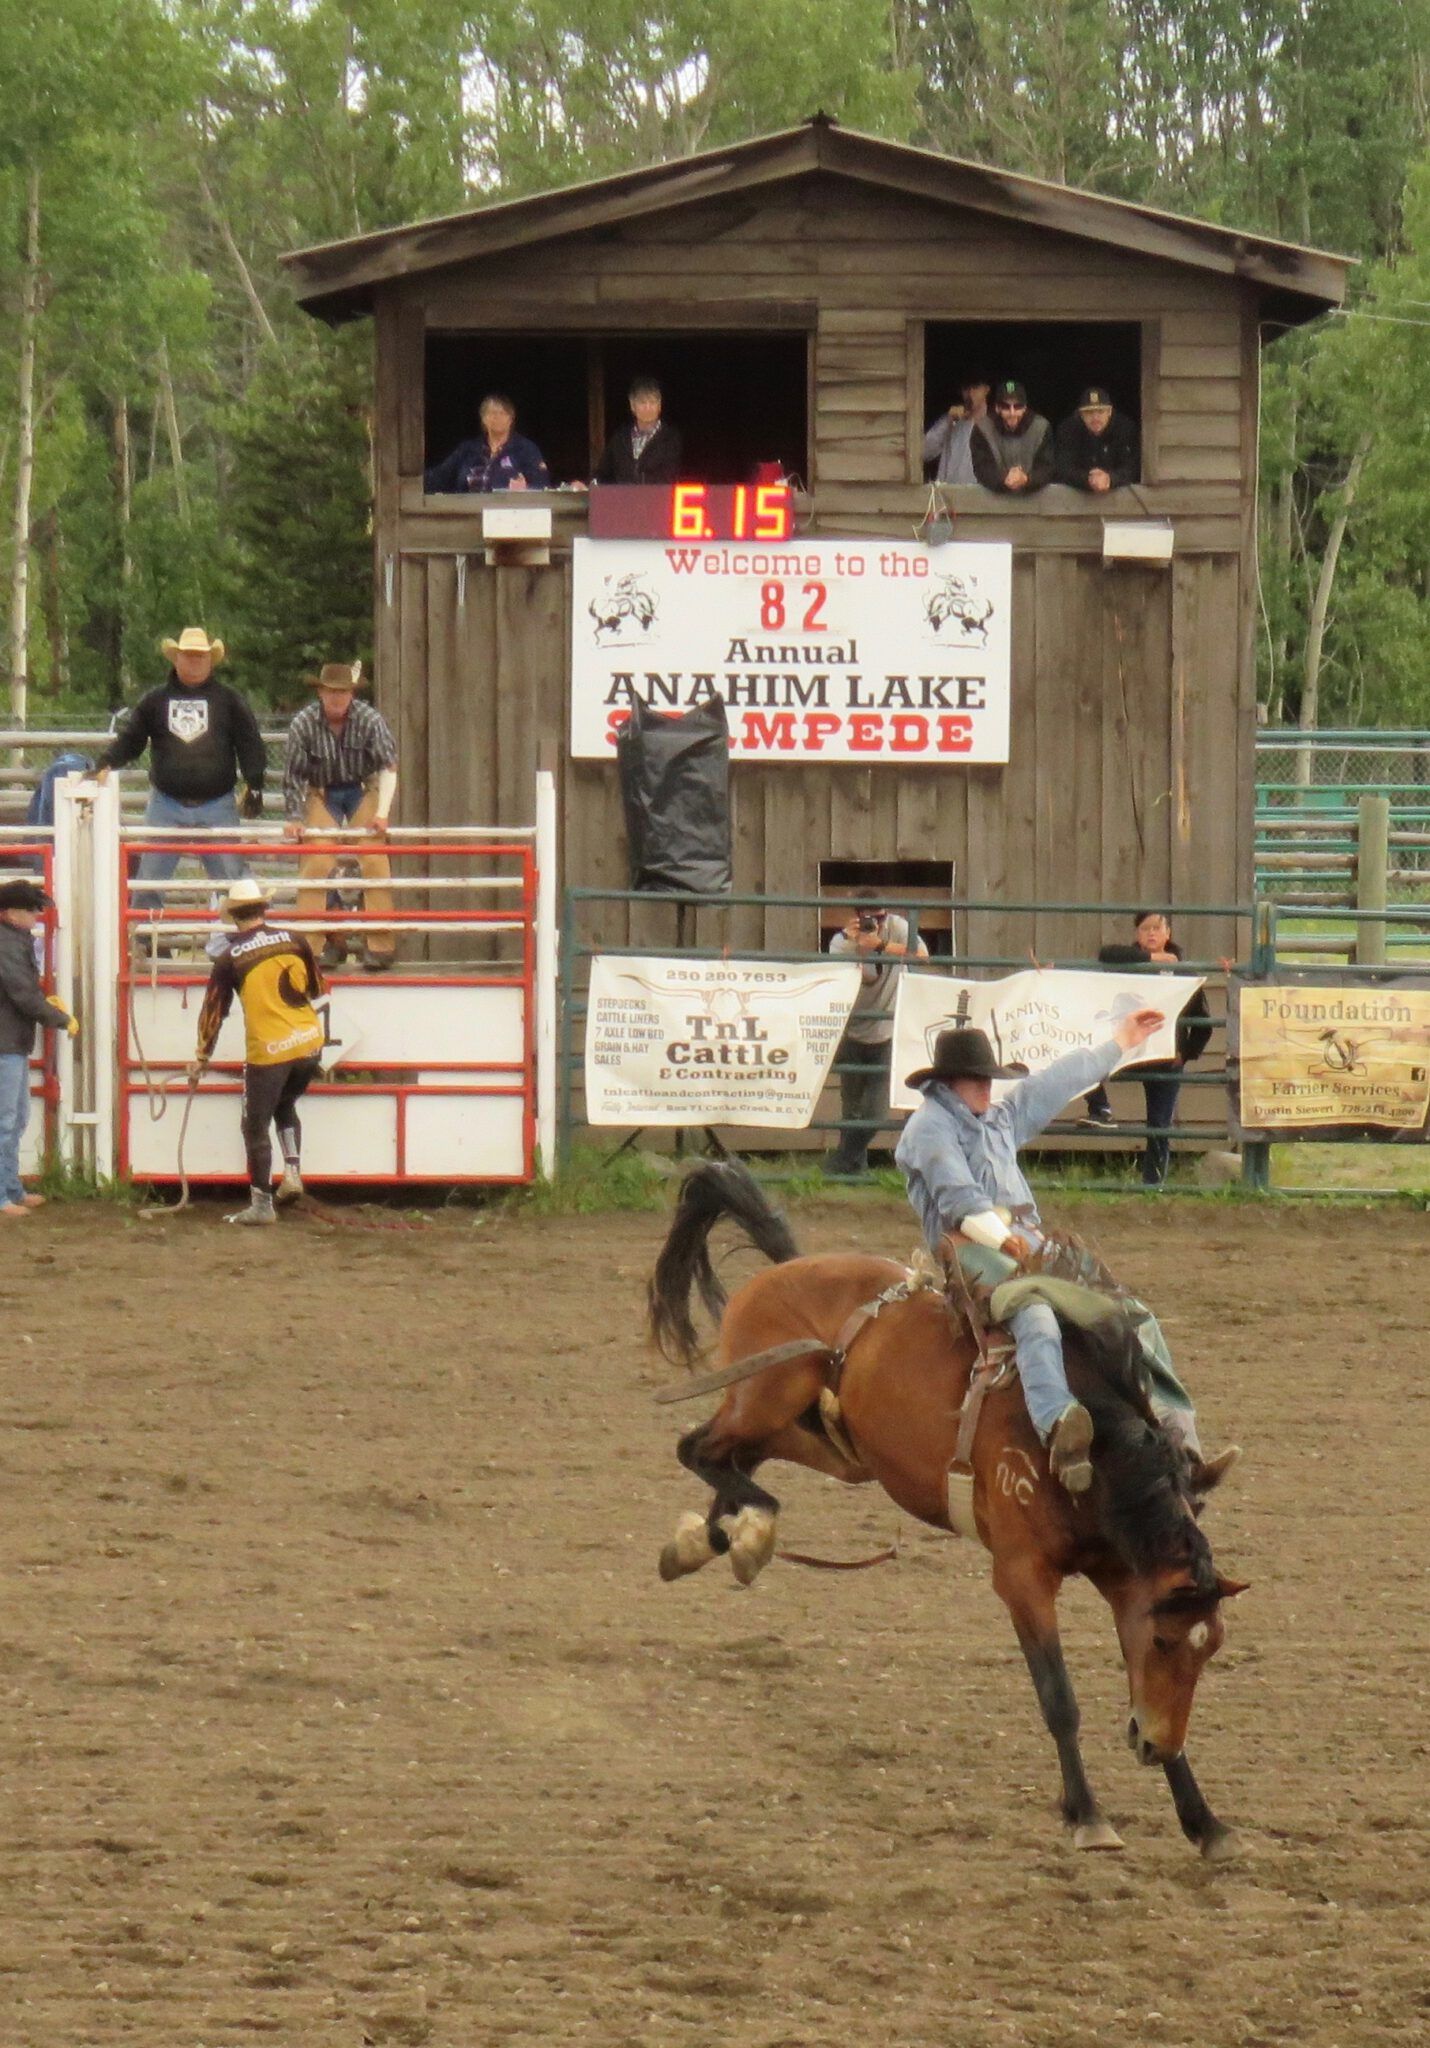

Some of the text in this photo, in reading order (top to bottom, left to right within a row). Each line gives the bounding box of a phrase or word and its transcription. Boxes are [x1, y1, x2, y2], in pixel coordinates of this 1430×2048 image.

[673, 484, 788, 538] 6.15
[665, 549, 929, 577] Welcome to the
[724, 638, 859, 664] Annual
[604, 672, 986, 709] ANAHIM LAKE
[605, 709, 975, 752] SMPEDE
[666, 969, 788, 983] 250 280 7653
[596, 1011, 660, 1025] CATTLE LINERS
[1005, 1001, 1060, 1022] KNIVES
[1262, 999, 1412, 1022] Foundation
[595, 1026, 602, 1038] 7
[604, 1027, 625, 1038] AXLE
[686, 1015, 768, 1041] TnL
[1010, 1021, 1092, 1045] & CUSTOM
[594, 1041, 622, 1053] GRAIN
[632, 1042, 649, 1053] HAY
[666, 1042, 789, 1065] Cattle
[806, 1041, 830, 1053] PILOT
[593, 1054, 622, 1065] SALES
[676, 1067, 797, 1084] Contracting
[1271, 1082, 1400, 1097] Farrier Services
[1254, 1105, 1292, 1116] Dustin
